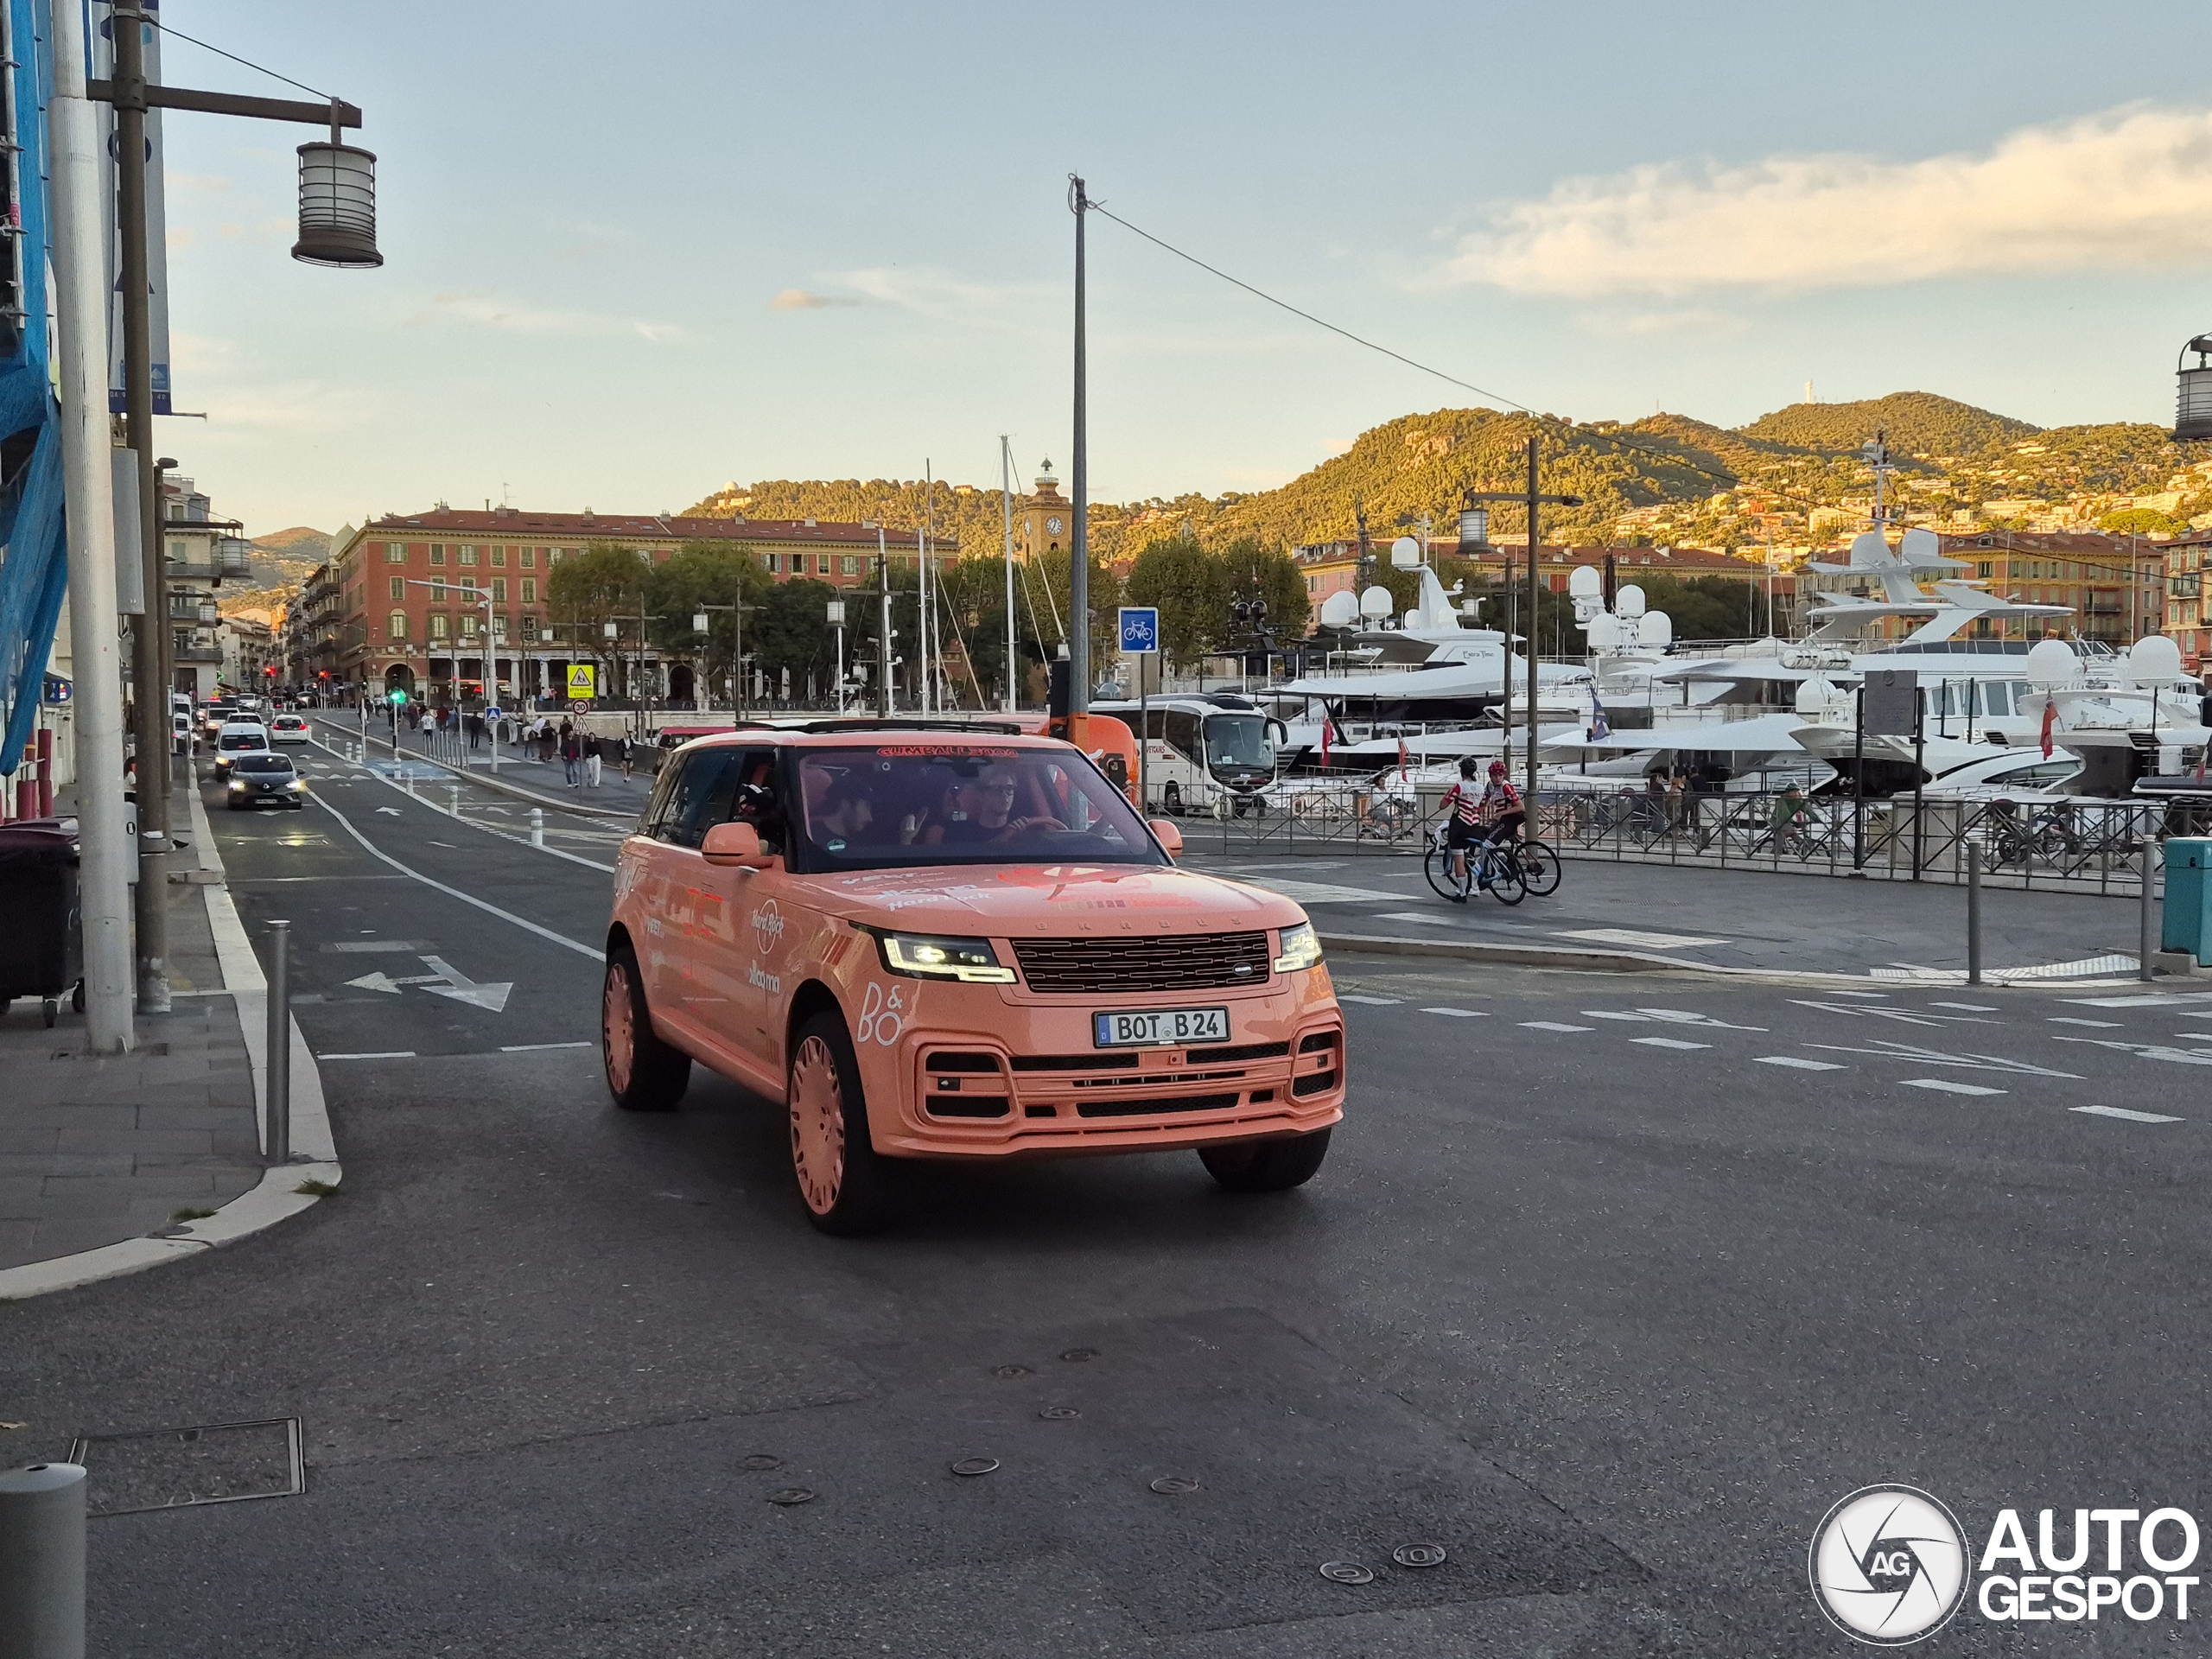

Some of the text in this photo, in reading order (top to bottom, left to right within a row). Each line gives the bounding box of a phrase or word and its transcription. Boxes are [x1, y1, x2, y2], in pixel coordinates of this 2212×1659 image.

[877, 746, 1019, 758] GUMBALL 3000
[887, 896, 938, 912] Hard
[767, 912, 785, 938] Rock
[1117, 1015, 1160, 1040] BOT
